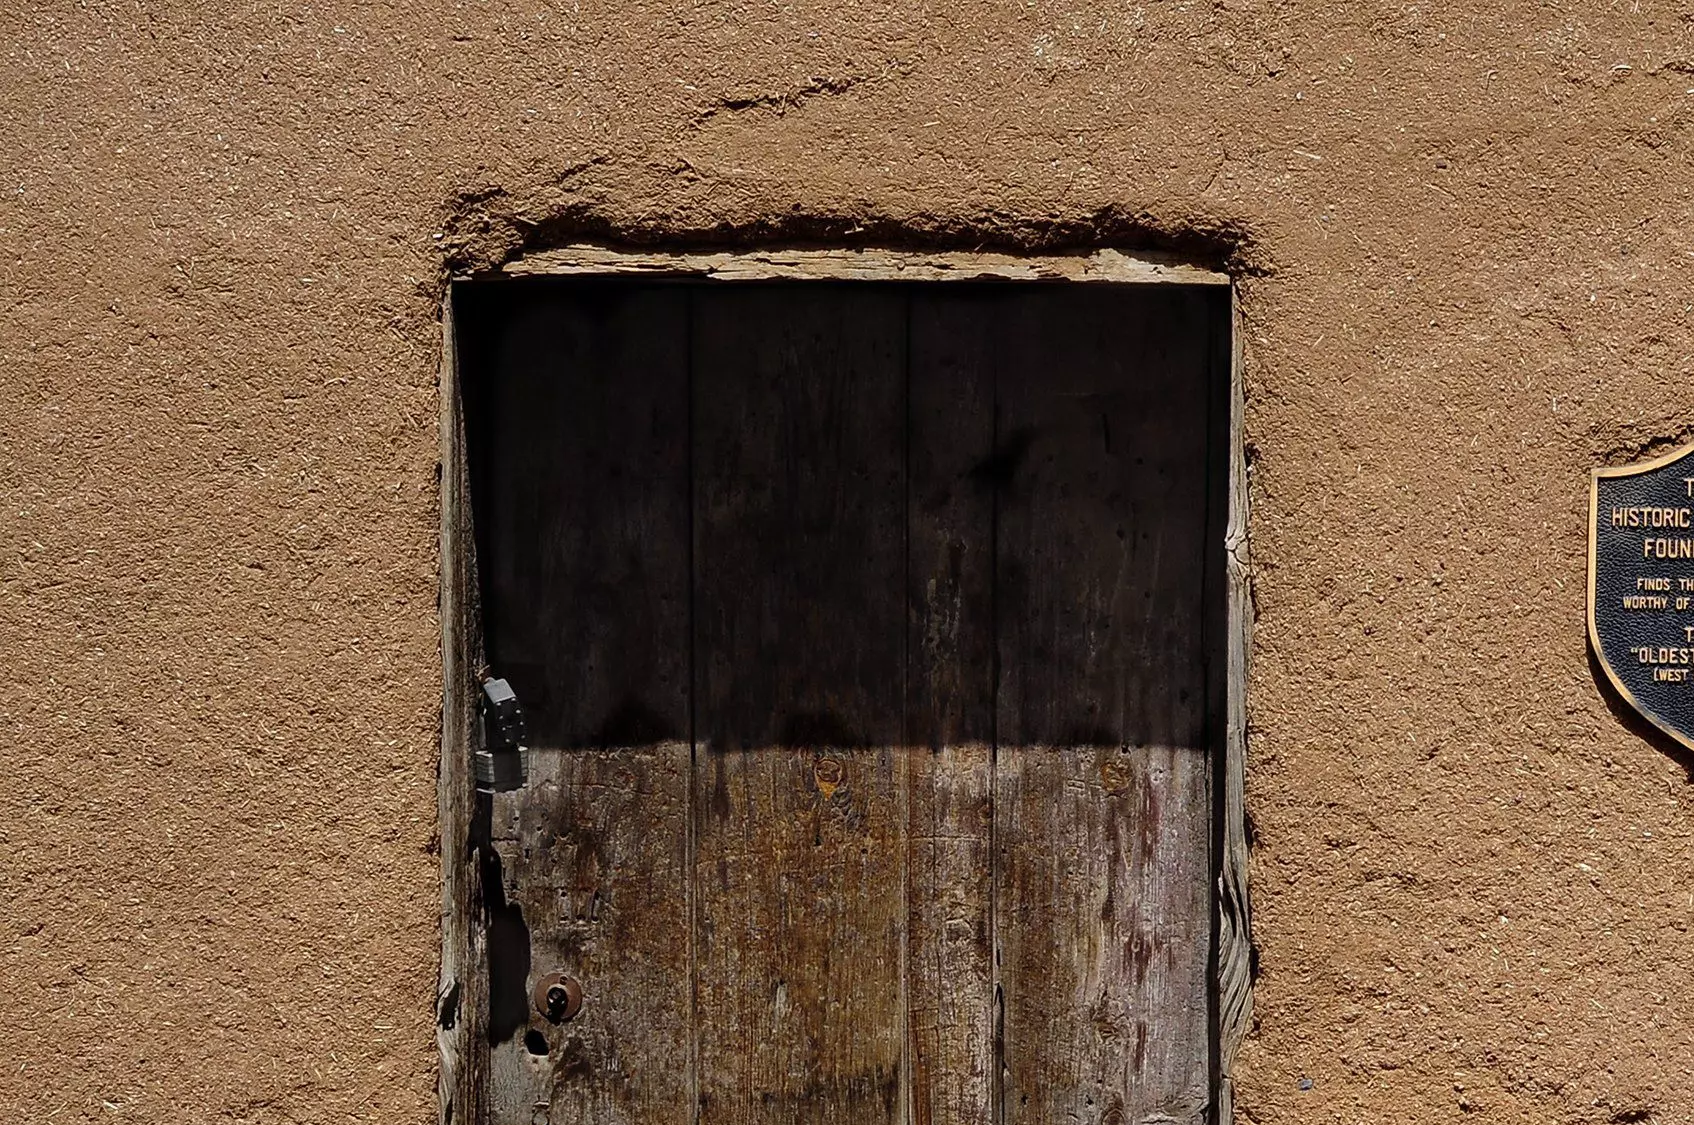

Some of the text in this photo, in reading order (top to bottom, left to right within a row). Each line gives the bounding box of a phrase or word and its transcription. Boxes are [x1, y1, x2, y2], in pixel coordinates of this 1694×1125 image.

[1613, 508, 1690, 527] HISTORIC
[1637, 579, 1670, 591] FINDS
[1623, 597, 1667, 609] WORTHY
[1676, 597, 1690, 609] OF
